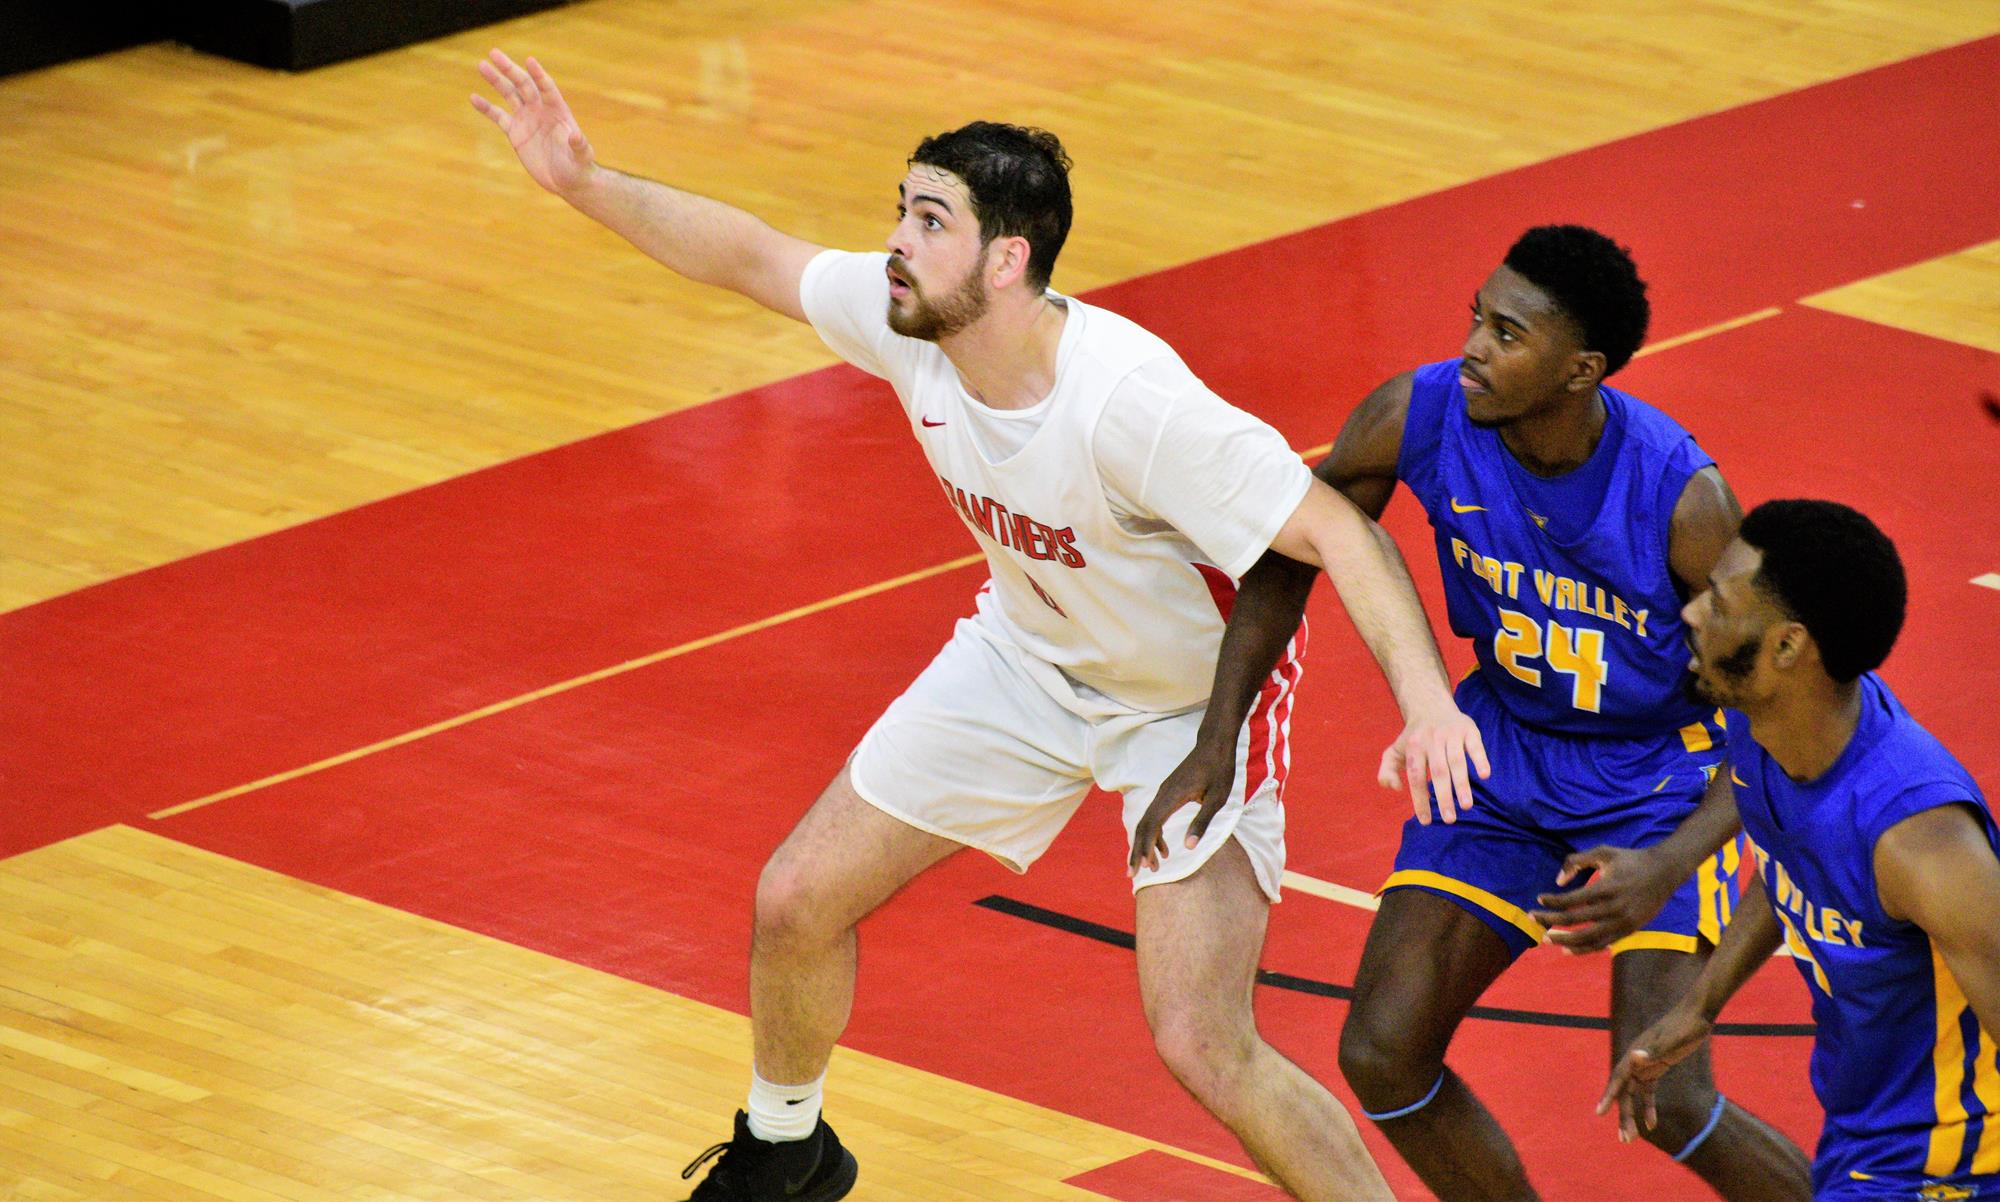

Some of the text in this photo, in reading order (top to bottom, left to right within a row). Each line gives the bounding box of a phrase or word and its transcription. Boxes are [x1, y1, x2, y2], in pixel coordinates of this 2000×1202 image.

[940, 475, 1086, 568] PANTHERS
[1450, 537, 1649, 637] FORT VALLEY
[1494, 606, 1608, 713] 24
[1775, 860, 1866, 948] VLEY
